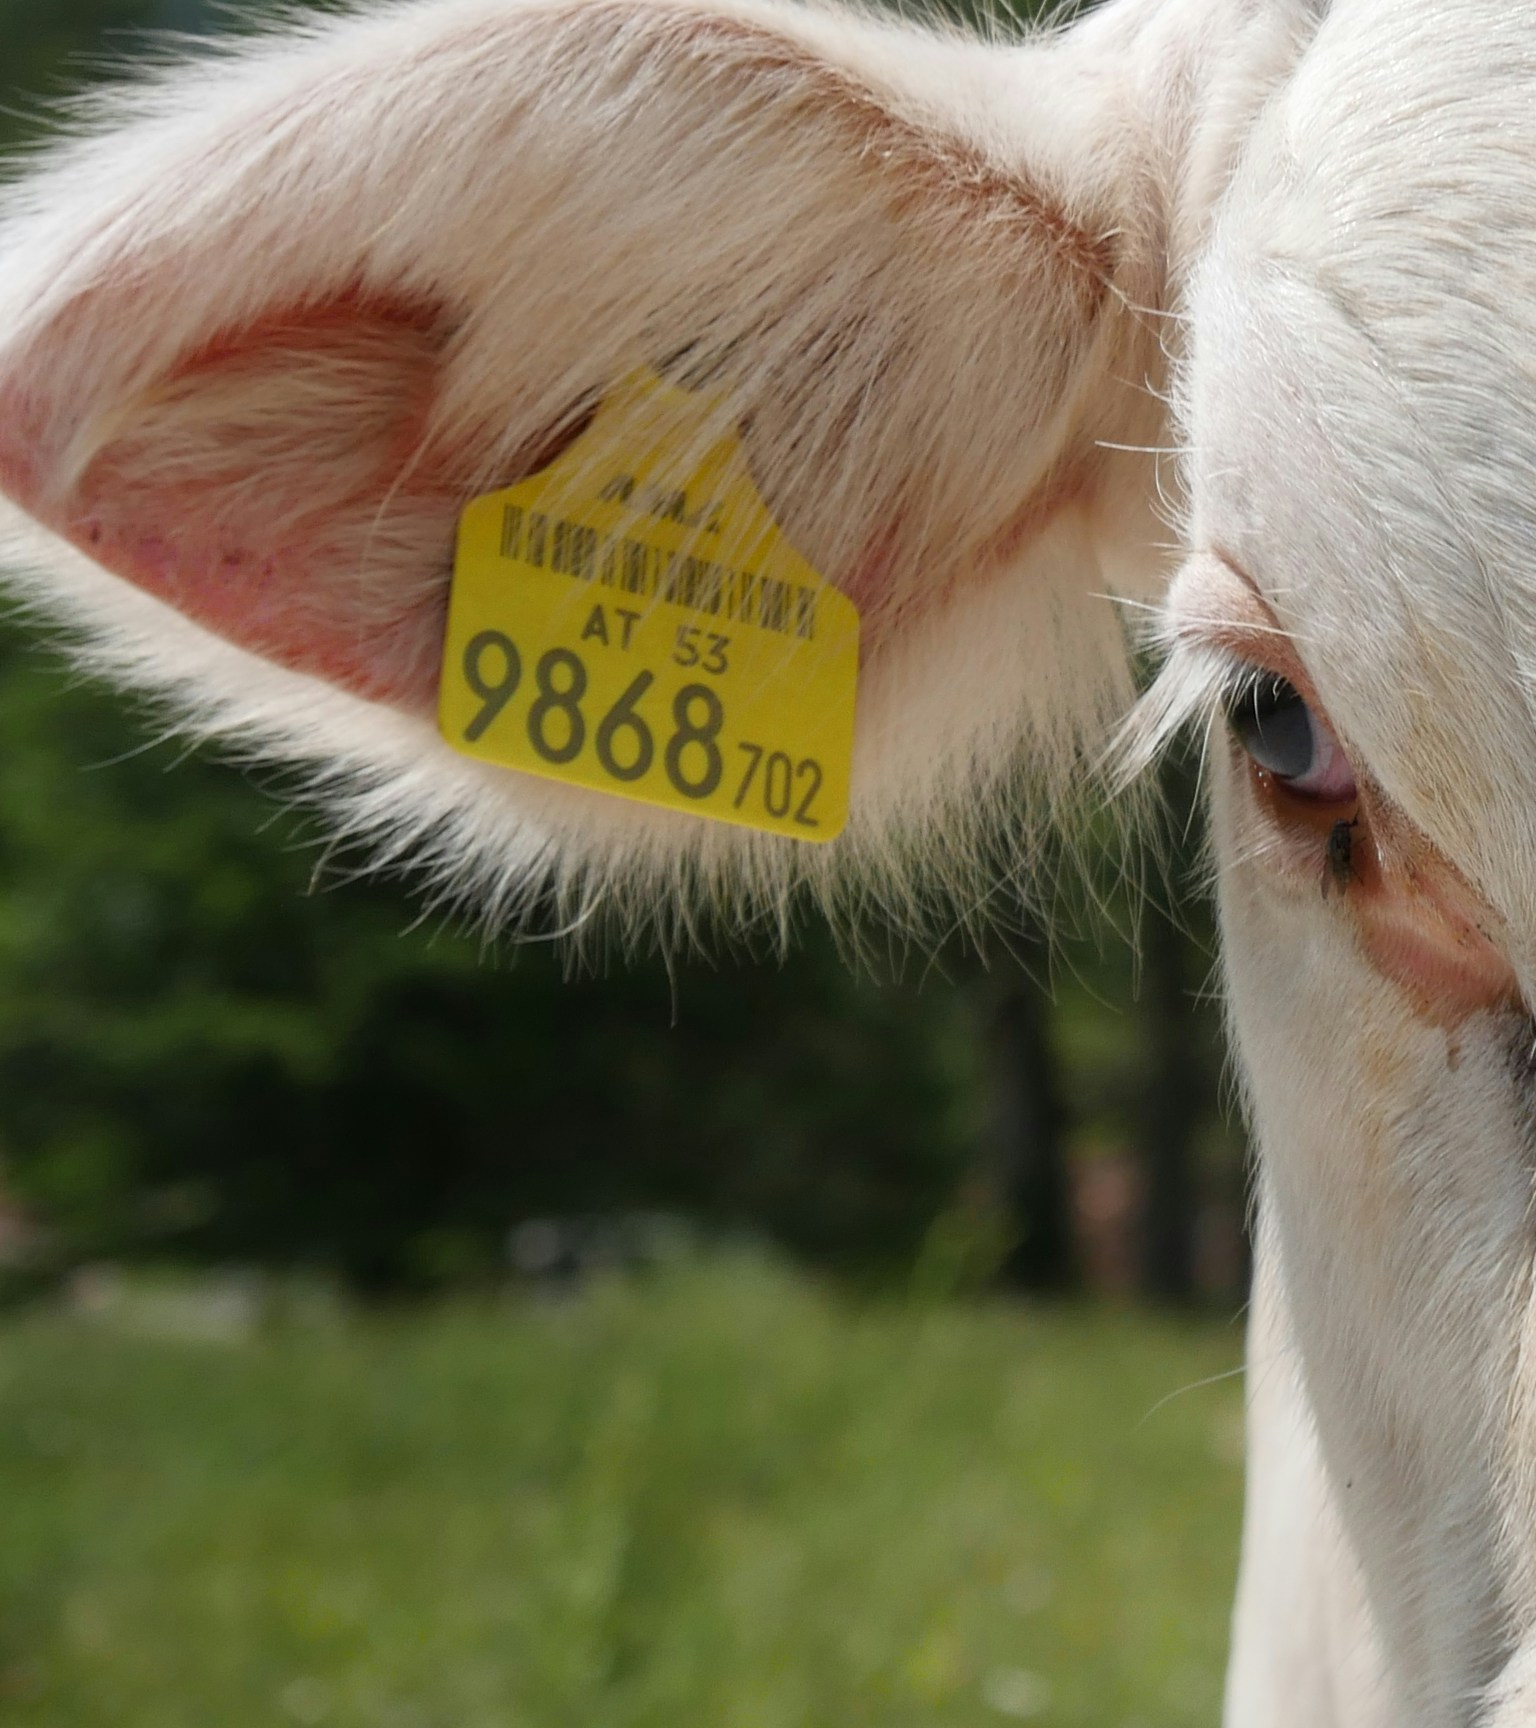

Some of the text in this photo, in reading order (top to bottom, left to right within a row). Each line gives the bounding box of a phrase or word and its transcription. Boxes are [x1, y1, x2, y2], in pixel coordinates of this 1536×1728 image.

[581, 605, 731, 675] AT 53
[463, 630, 823, 827] 9868 702
